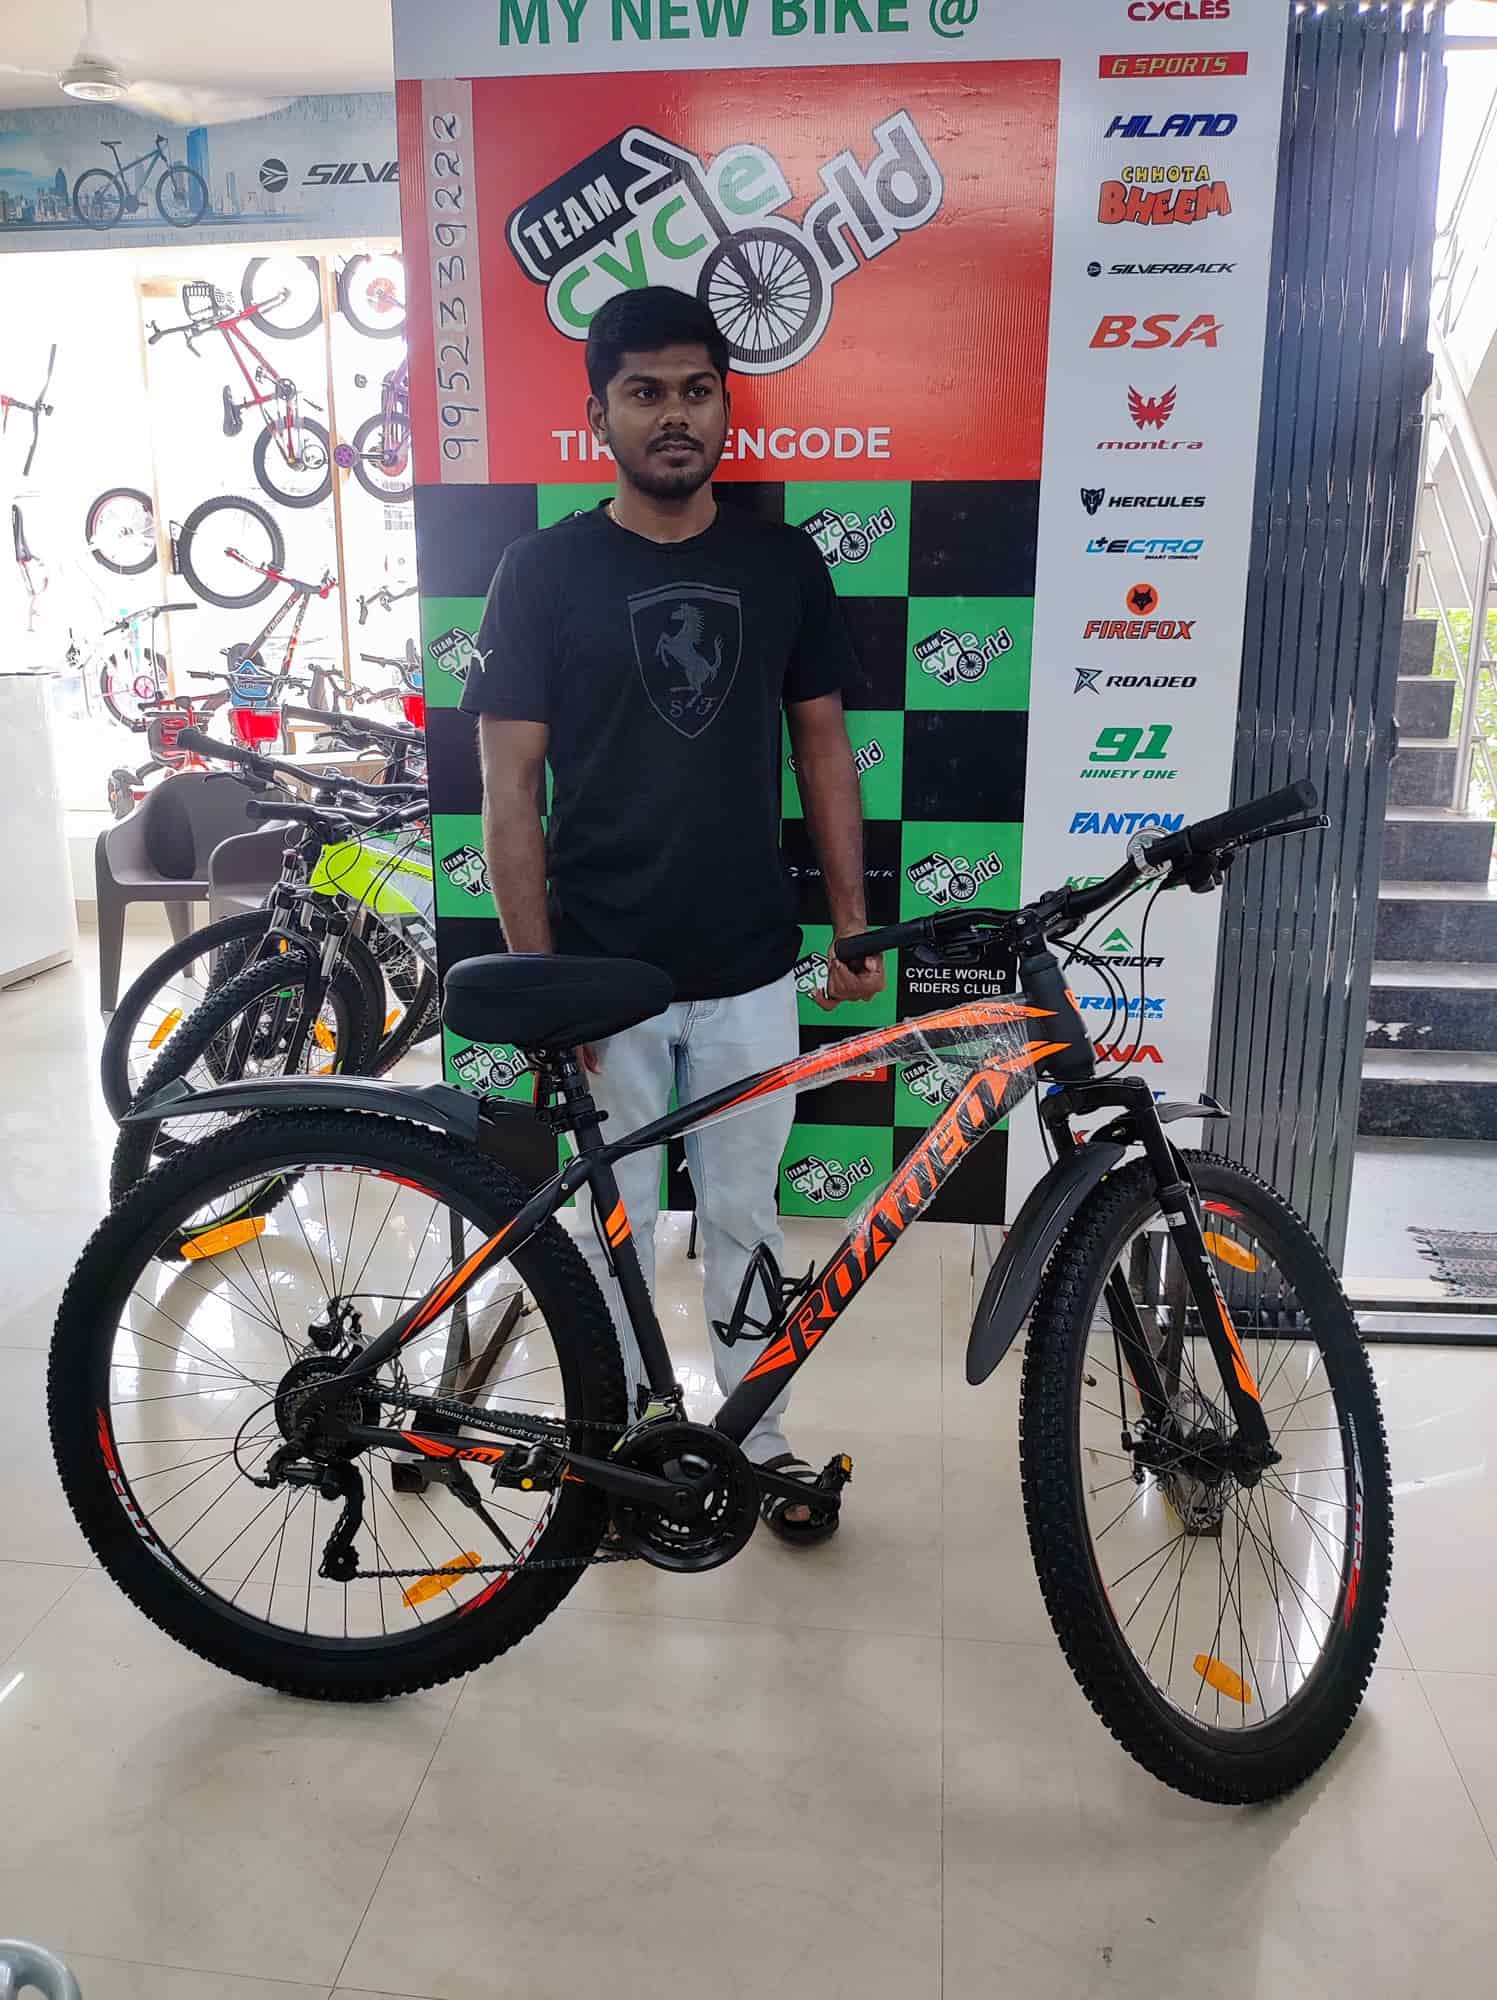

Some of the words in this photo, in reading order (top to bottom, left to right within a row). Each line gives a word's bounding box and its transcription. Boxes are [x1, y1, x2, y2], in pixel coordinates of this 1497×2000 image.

[1128, 0, 1230, 21] CYCLES
[499, 0, 584, 46] MY
[612, 0, 736, 41] NEW
[771, 0, 910, 37] BIKE
[1111, 58, 1129, 75] G
[1135, 56, 1228, 74] SPORTS
[1104, 114, 1238, 138] HILAND
[1122, 165, 1210, 183] CHHOTA
[1098, 181, 1232, 226] BHEEM
[522, 175, 622, 262] TEAM
[1107, 262, 1237, 276] SILVERBACK
[1089, 314, 1224, 350] BSA
[551, 428, 891, 461] TIRENGODE
[1096, 438, 1204, 450] montra
[1108, 496, 1206, 508] HERCULES
[1083, 620, 1196, 640] FIREFOX
[916, 639, 941, 658] TEAM
[1106, 675, 1197, 688] ROADEO
[1089, 725, 1172, 763] 91
[1080, 769, 1139, 779] NINETY
[1142, 770, 1178, 779] ONE
[1069, 812, 1184, 834] FANTOM
[910, 862, 934, 880] TEAM
[906, 968, 950, 980] CYCLE
[954, 968, 1006, 981] WORLD
[909, 983, 960, 994] RIDERS
[964, 984, 1001, 995] CLUB
